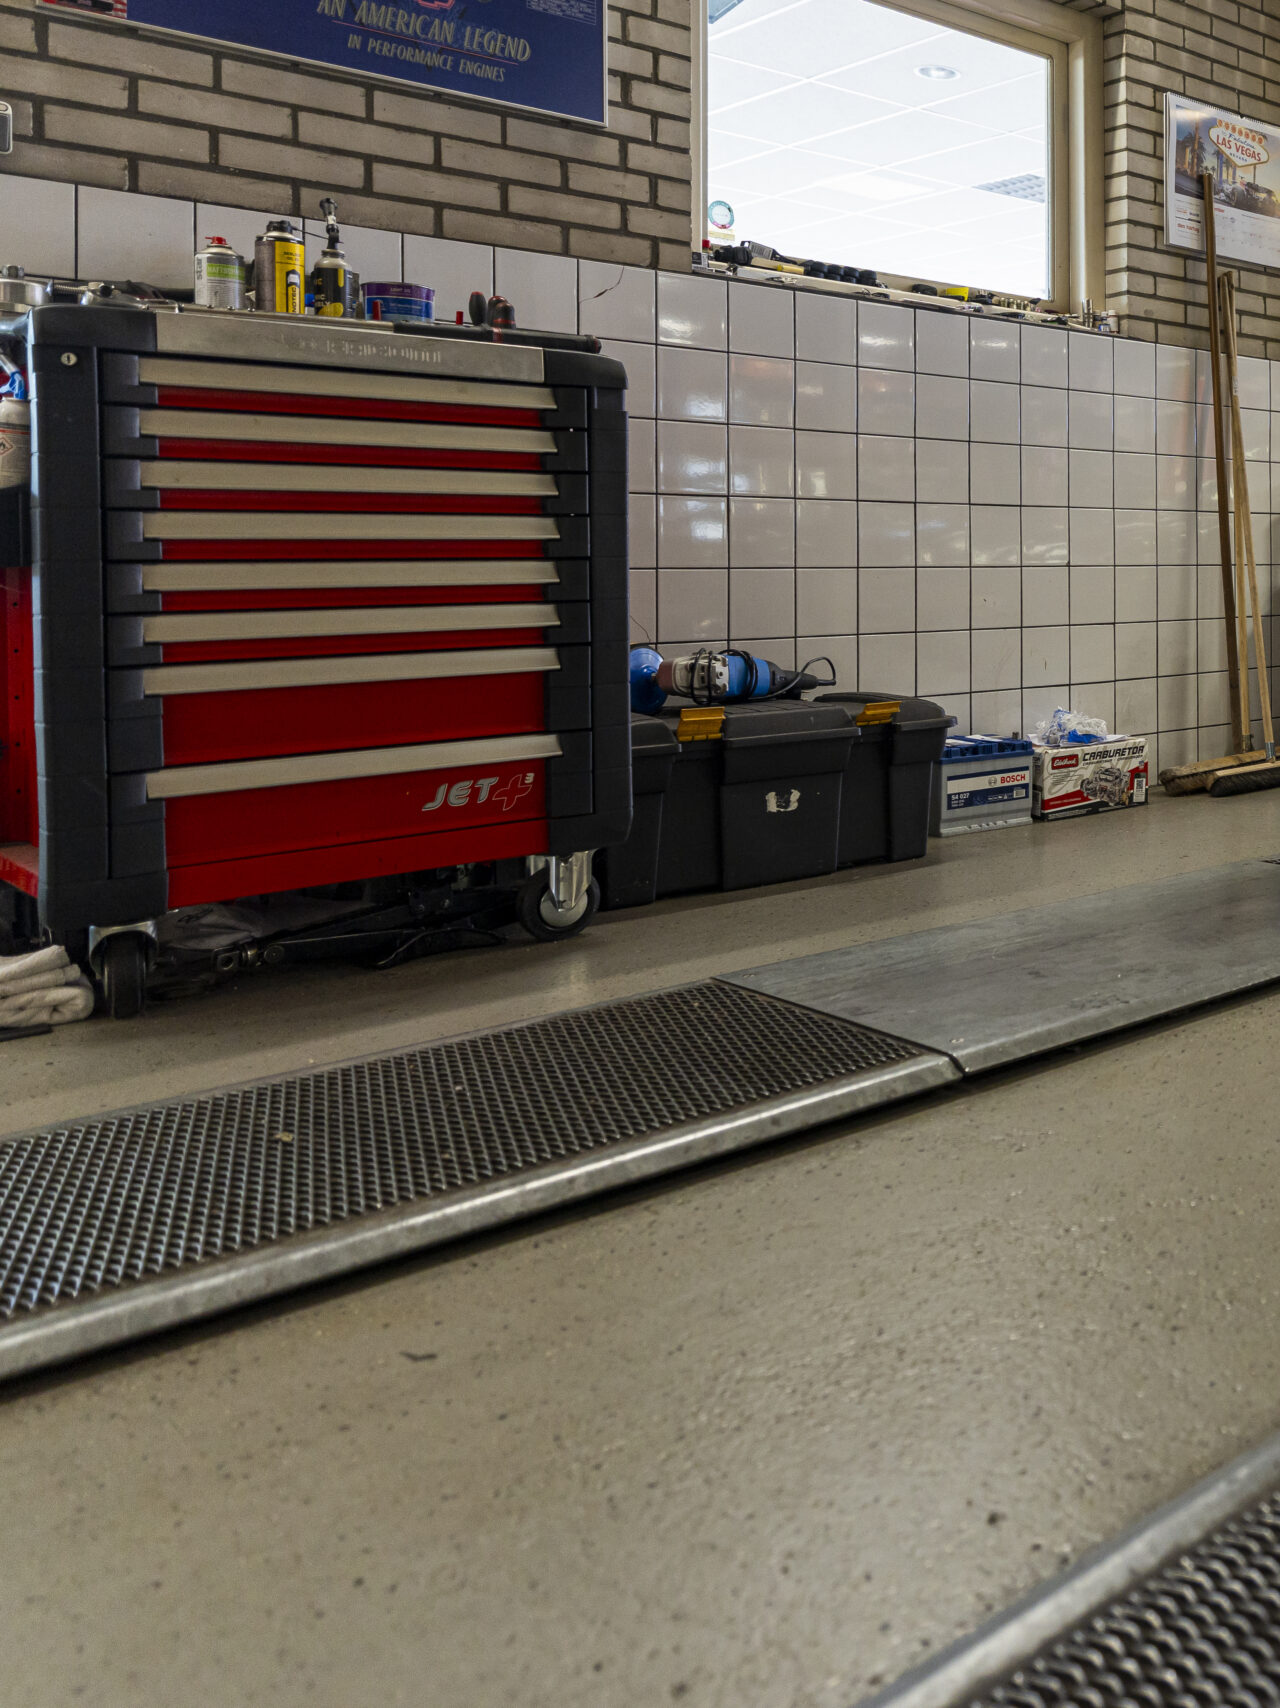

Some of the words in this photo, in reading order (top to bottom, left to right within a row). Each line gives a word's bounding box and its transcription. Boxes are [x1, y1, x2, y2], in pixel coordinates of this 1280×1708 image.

[316, 0, 345, 18] AN
[355, 3, 454, 43] AMERICAN
[464, 26, 531, 62] LEGEND
[348, 34, 361, 49] IN
[367, 38, 454, 71] PERFORMANCE
[459, 59, 506, 82] ENGINES
[1216, 134, 1232, 150] LAS
[1235, 142, 1262, 162] VEGAS
[1082, 745, 1146, 762] CARBURETOR
[421, 776, 500, 811] JET
[1000, 774, 1026, 784] BOSCH
